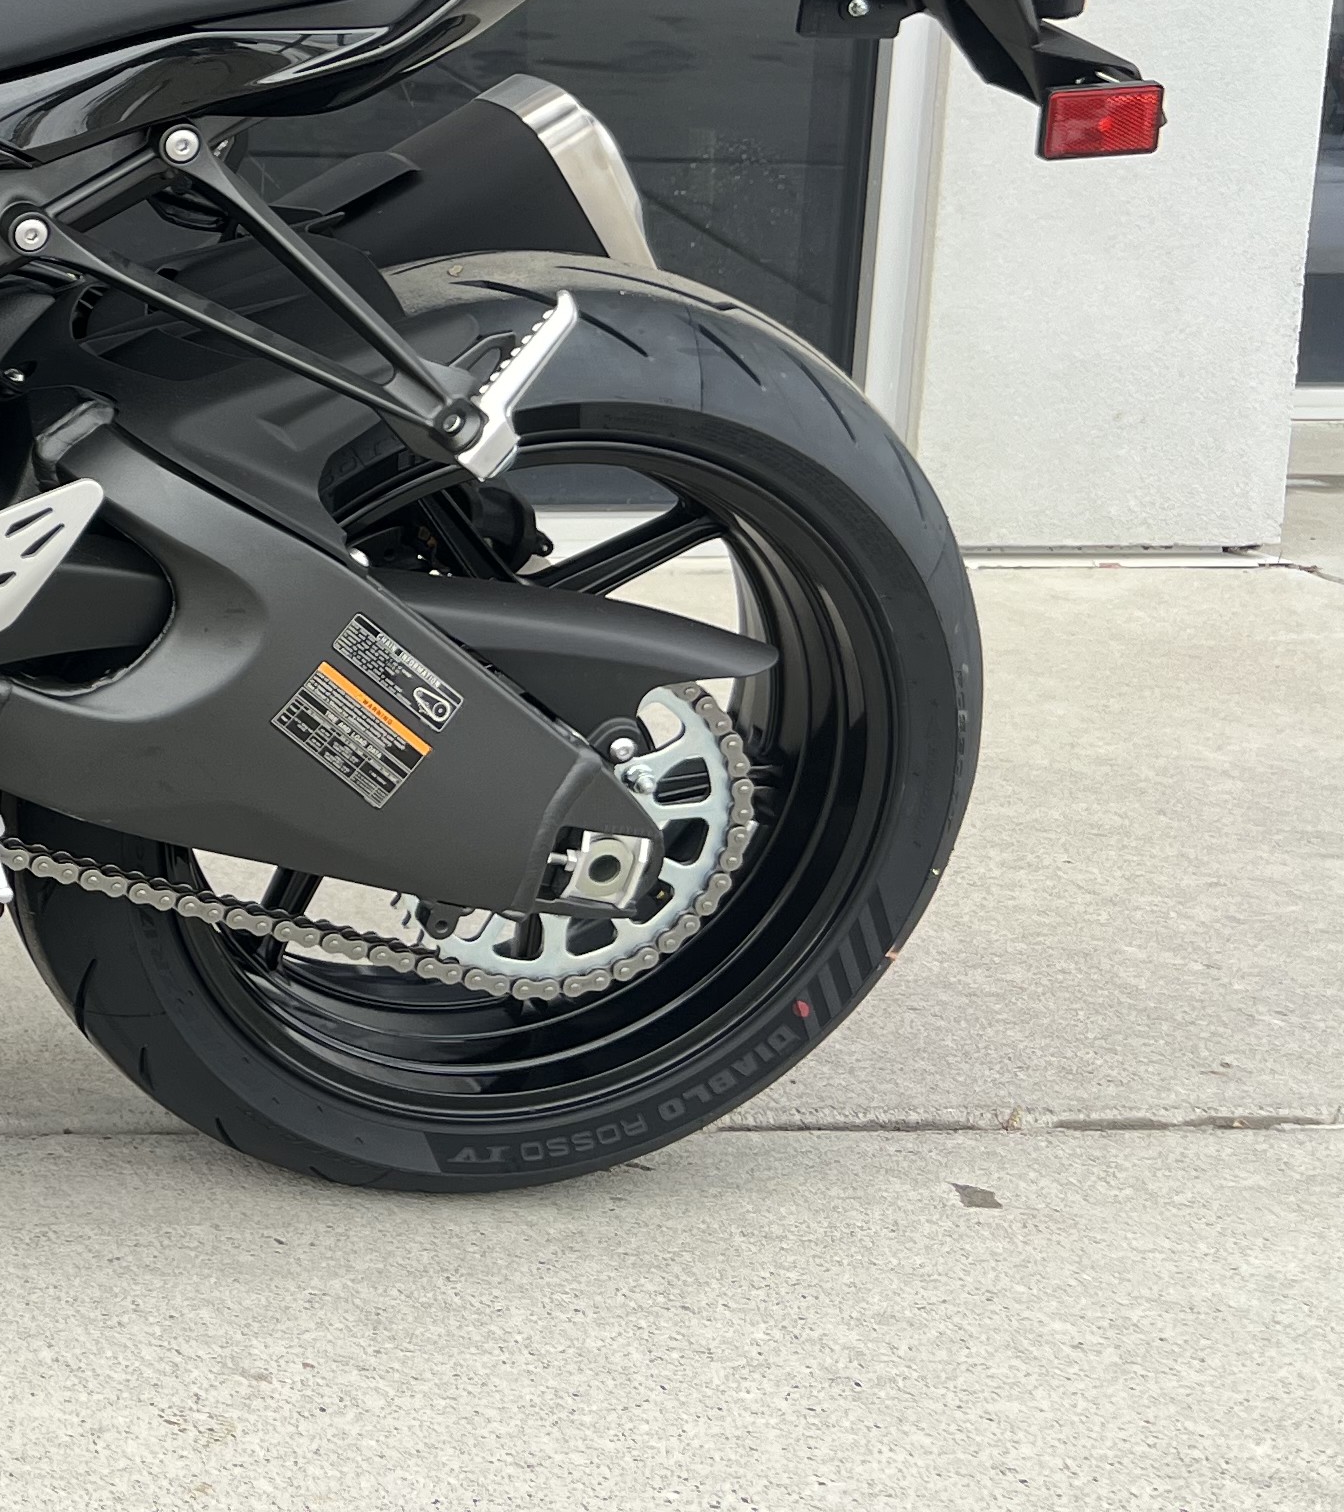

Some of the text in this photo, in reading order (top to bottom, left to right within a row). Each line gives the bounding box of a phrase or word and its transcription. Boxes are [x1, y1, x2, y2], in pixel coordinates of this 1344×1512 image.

[376, 632, 398, 652] CHAIN
[362, 699, 394, 726] WARNING
[659, 1025, 800, 1121] DIABLO
[520, 1118, 648, 1162] ROSSO
